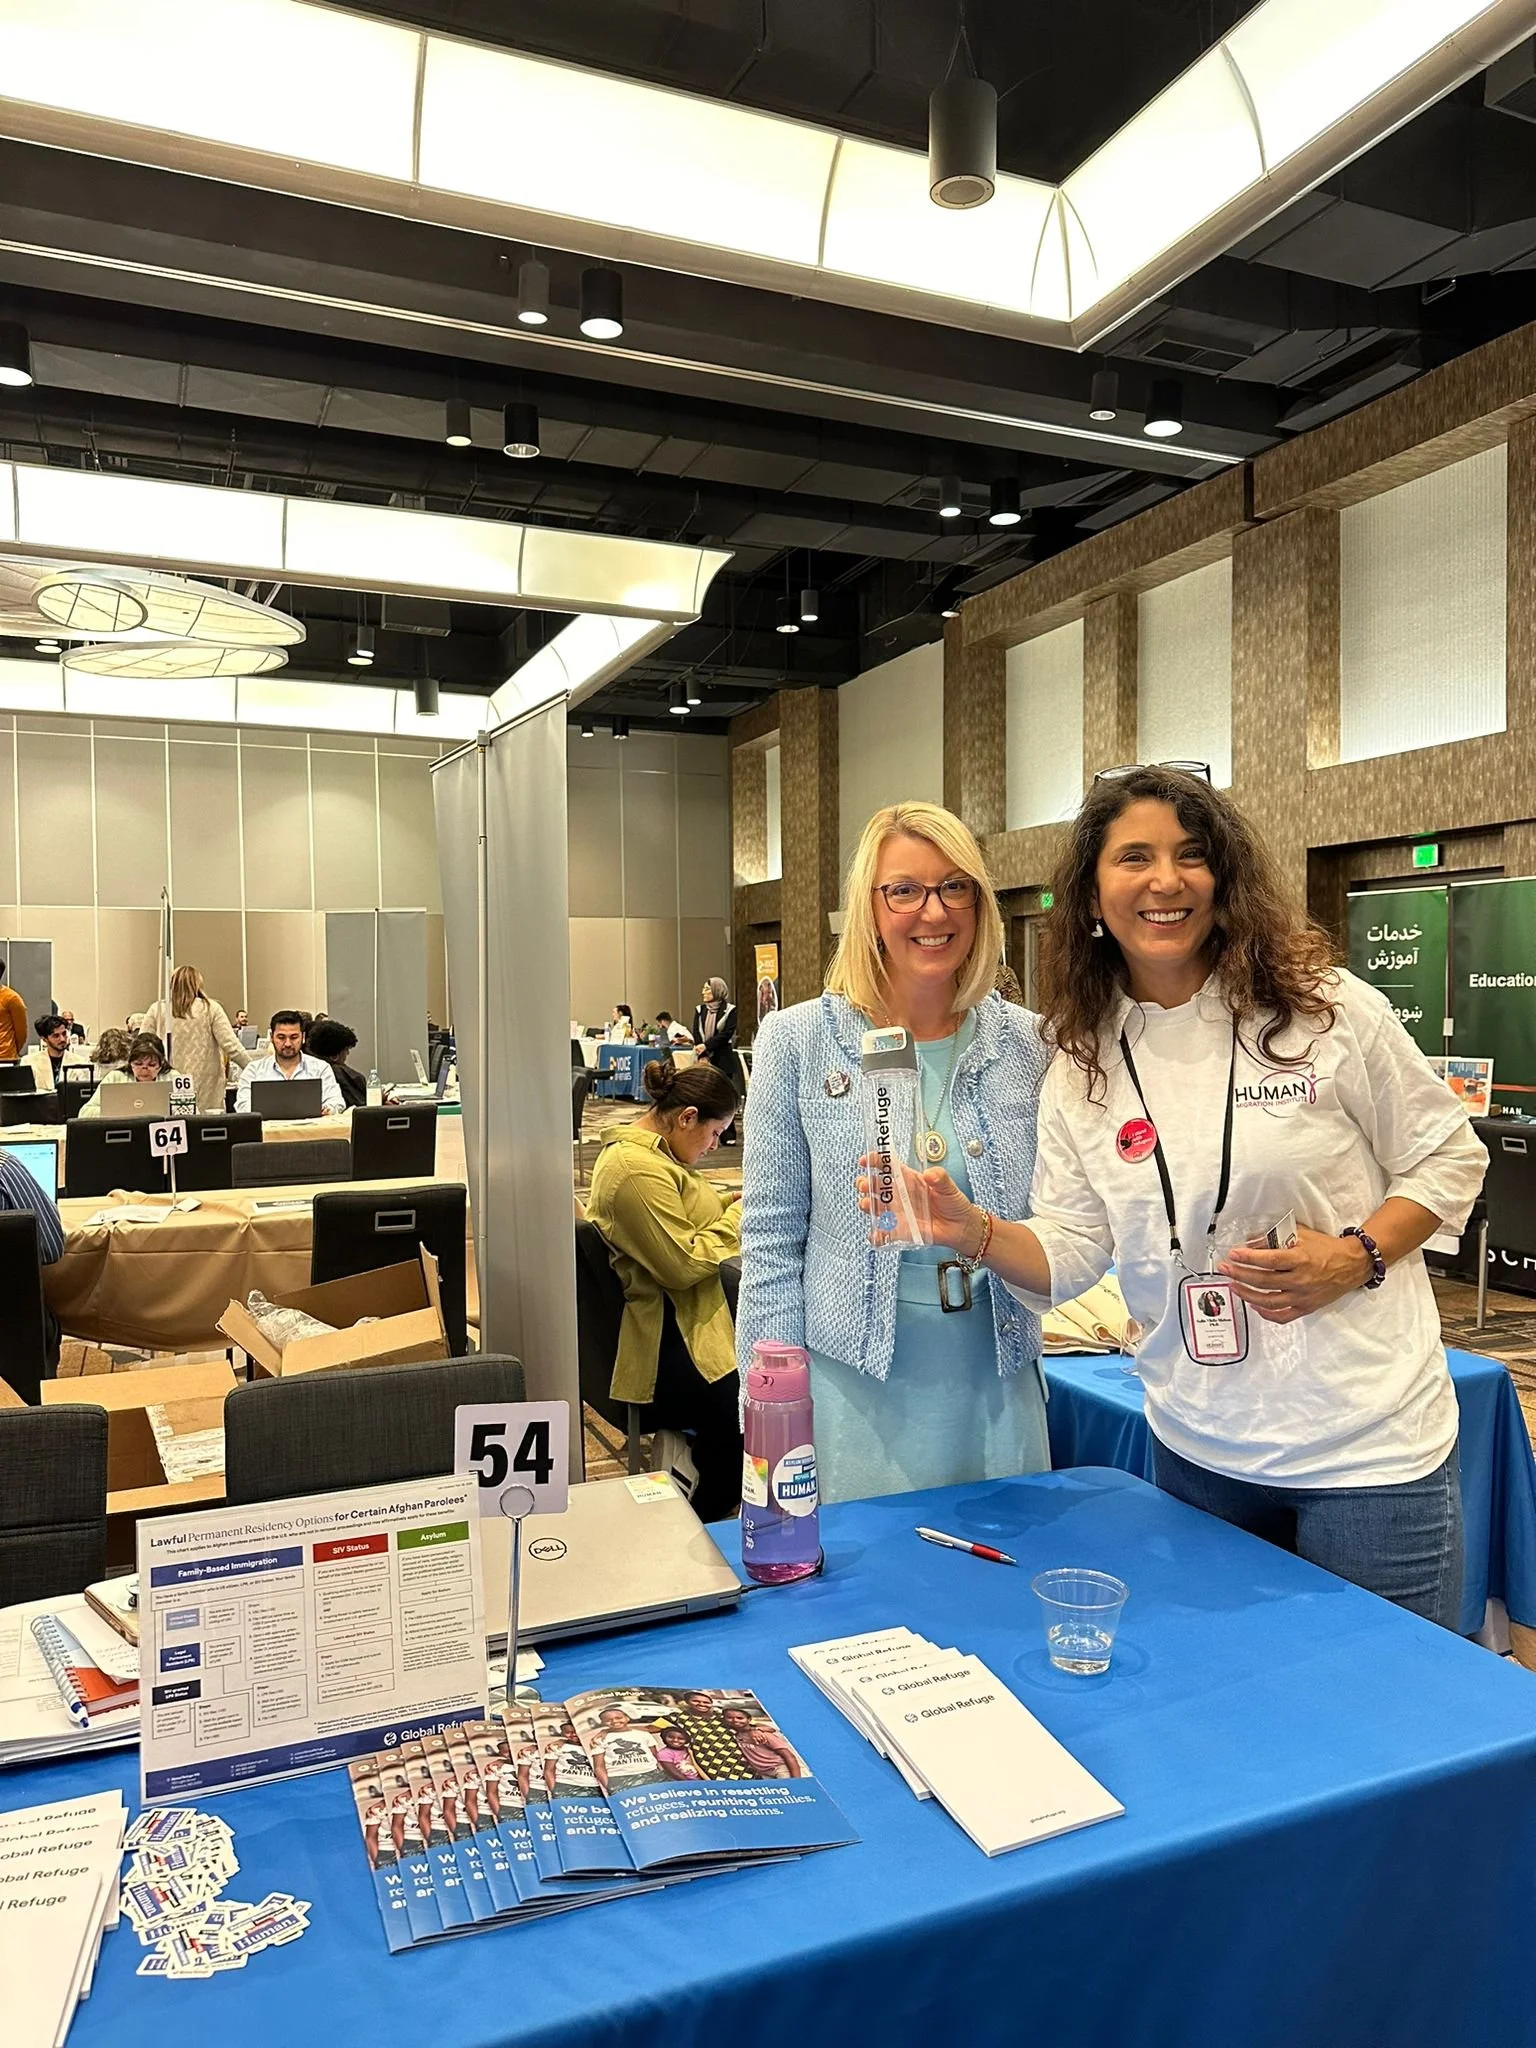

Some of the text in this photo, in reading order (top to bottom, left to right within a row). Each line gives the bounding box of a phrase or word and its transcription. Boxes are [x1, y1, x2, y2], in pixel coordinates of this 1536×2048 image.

[1367, 923, 1423, 941] خدمات
[1368, 947, 1420, 970] آموزش
[1469, 972, 1536, 987] Educatio
[175, 1077, 191, 1089] 66
[1235, 1082, 1307, 1102] HUMAN
[1236, 1096, 1308, 1108] MIGRATION INSTITUTE
[155, 1126, 182, 1147] 64
[877, 1086, 893, 1204] Global Refuge
[468, 1421, 554, 1488] 54
[150, 1533, 187, 1548] Lawful
[188, 1527, 243, 1542] Permanent
[245, 1520, 294, 1535] Residency
[295, 1513, 334, 1529] Options
[334, 1512, 350, 1522] for
[350, 1505, 388, 1519] Certain
[388, 1502, 424, 1516] Afghan
[420, 1531, 447, 1542] Asylum
[332, 1542, 370, 1555] SIV Status
[533, 1544, 564, 1555] DELL
[178, 1556, 278, 1578] Family-Based Immigration
[897, 1669, 971, 1691] Global Refuge
[920, 1694, 996, 1718] Global Refuge
[400, 1725, 436, 1741] Global
[619, 1785, 790, 1809] We believe in resettling
[625, 1801, 690, 1820] refugees,
[691, 1796, 758, 1808] reuniting
[758, 1794, 816, 1806] families,
[560, 1805, 588, 1814] We
[630, 1813, 661, 1830] and
[663, 1807, 728, 1824] realizing
[729, 1806, 784, 1817] dreams.
[566, 1825, 597, 1836] and
[0, 1840, 93, 1861] obal Refuge
[32, 1866, 90, 1880] Refuge
[7, 1895, 68, 1910] Refuge
[236, 1916, 298, 1952] Human.
